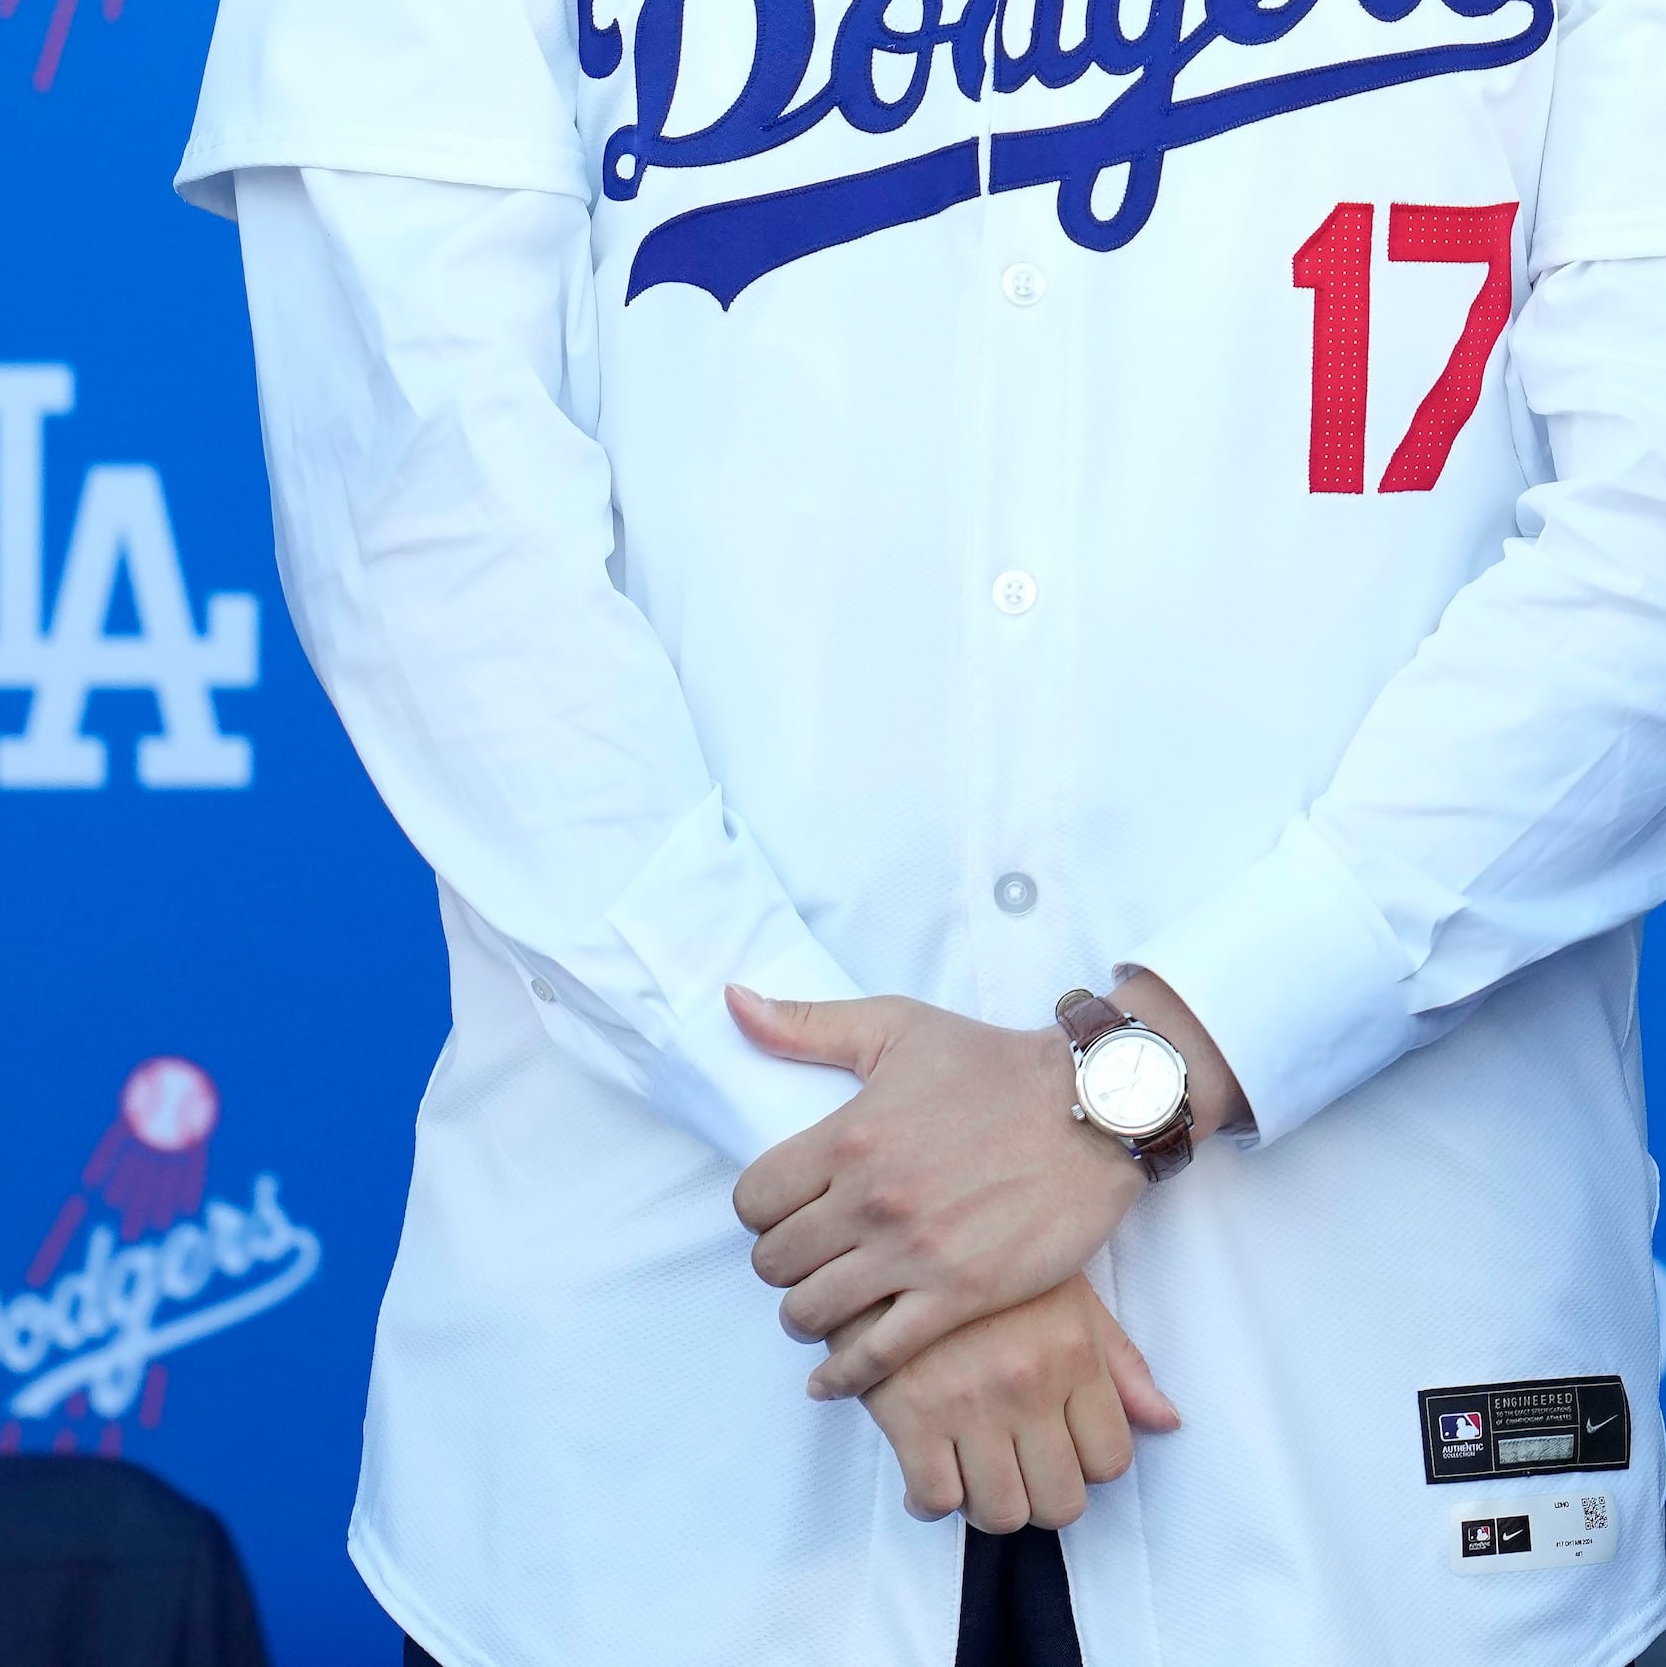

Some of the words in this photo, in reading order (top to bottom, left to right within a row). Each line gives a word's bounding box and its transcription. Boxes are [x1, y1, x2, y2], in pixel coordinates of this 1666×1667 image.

[1292, 200, 1520, 494] 17
[1494, 1392, 1573, 1409] ENGINEERED
[1442, 1442, 1484, 1454] AUTHENTIC
